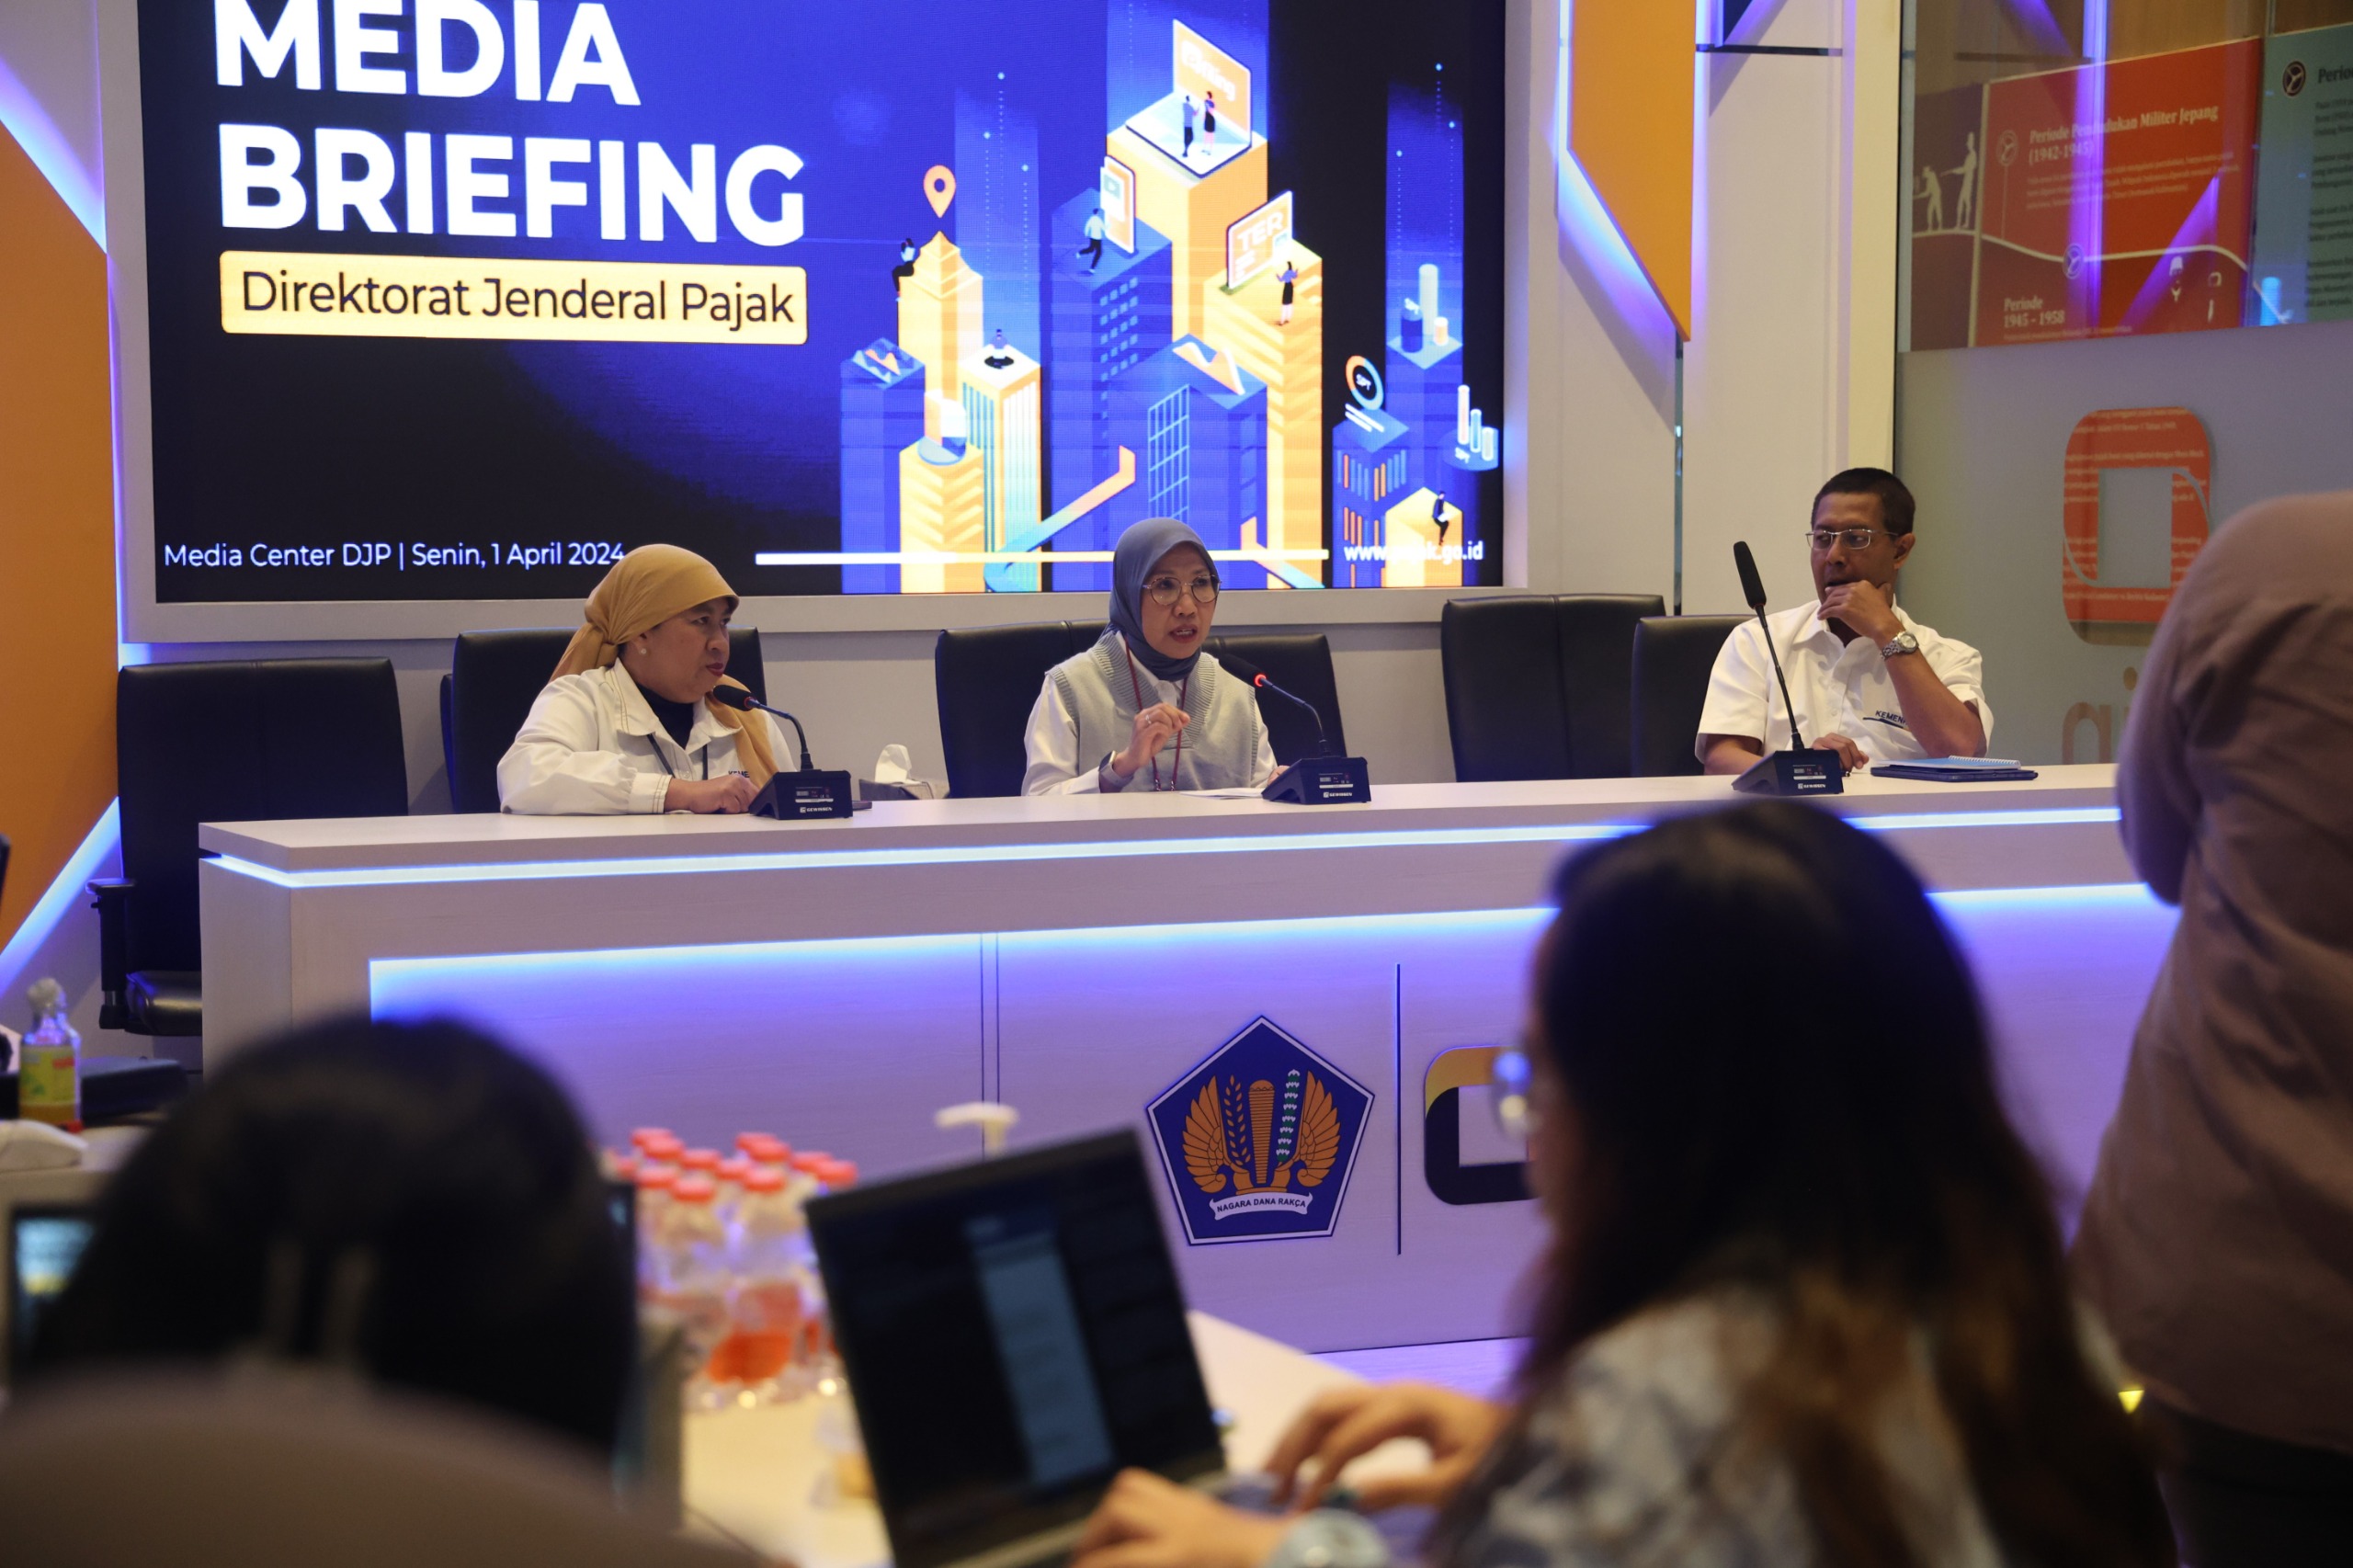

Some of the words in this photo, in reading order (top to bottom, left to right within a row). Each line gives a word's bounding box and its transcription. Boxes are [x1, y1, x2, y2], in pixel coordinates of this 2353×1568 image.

[215, 0, 642, 106] MEDIA
[2317, 64, 2353, 84] Perio
[2029, 125, 2070, 144] Periode
[2140, 108, 2178, 129] Militer
[2178, 105, 2219, 126] Jepang
[219, 123, 804, 246] BRIEFING
[1236, 211, 1284, 252] TER
[242, 270, 471, 317] Direktorat
[482, 278, 666, 322] Jenderal
[682, 282, 794, 332] Pajak
[165, 543, 243, 567] Media
[250, 543, 335, 566] Center
[343, 543, 392, 566] DJP
[413, 542, 486, 569] Senin,
[492, 543, 499, 565] 1
[506, 541, 562, 571] April
[568, 542, 624, 566] 2024
[1344, 540, 1483, 565] www.pjk.go.id
[1217, 1199, 1252, 1212] NAGARA
[1254, 1198, 1276, 1206] DANA
[1278, 1198, 1306, 1208] RAKÇA
